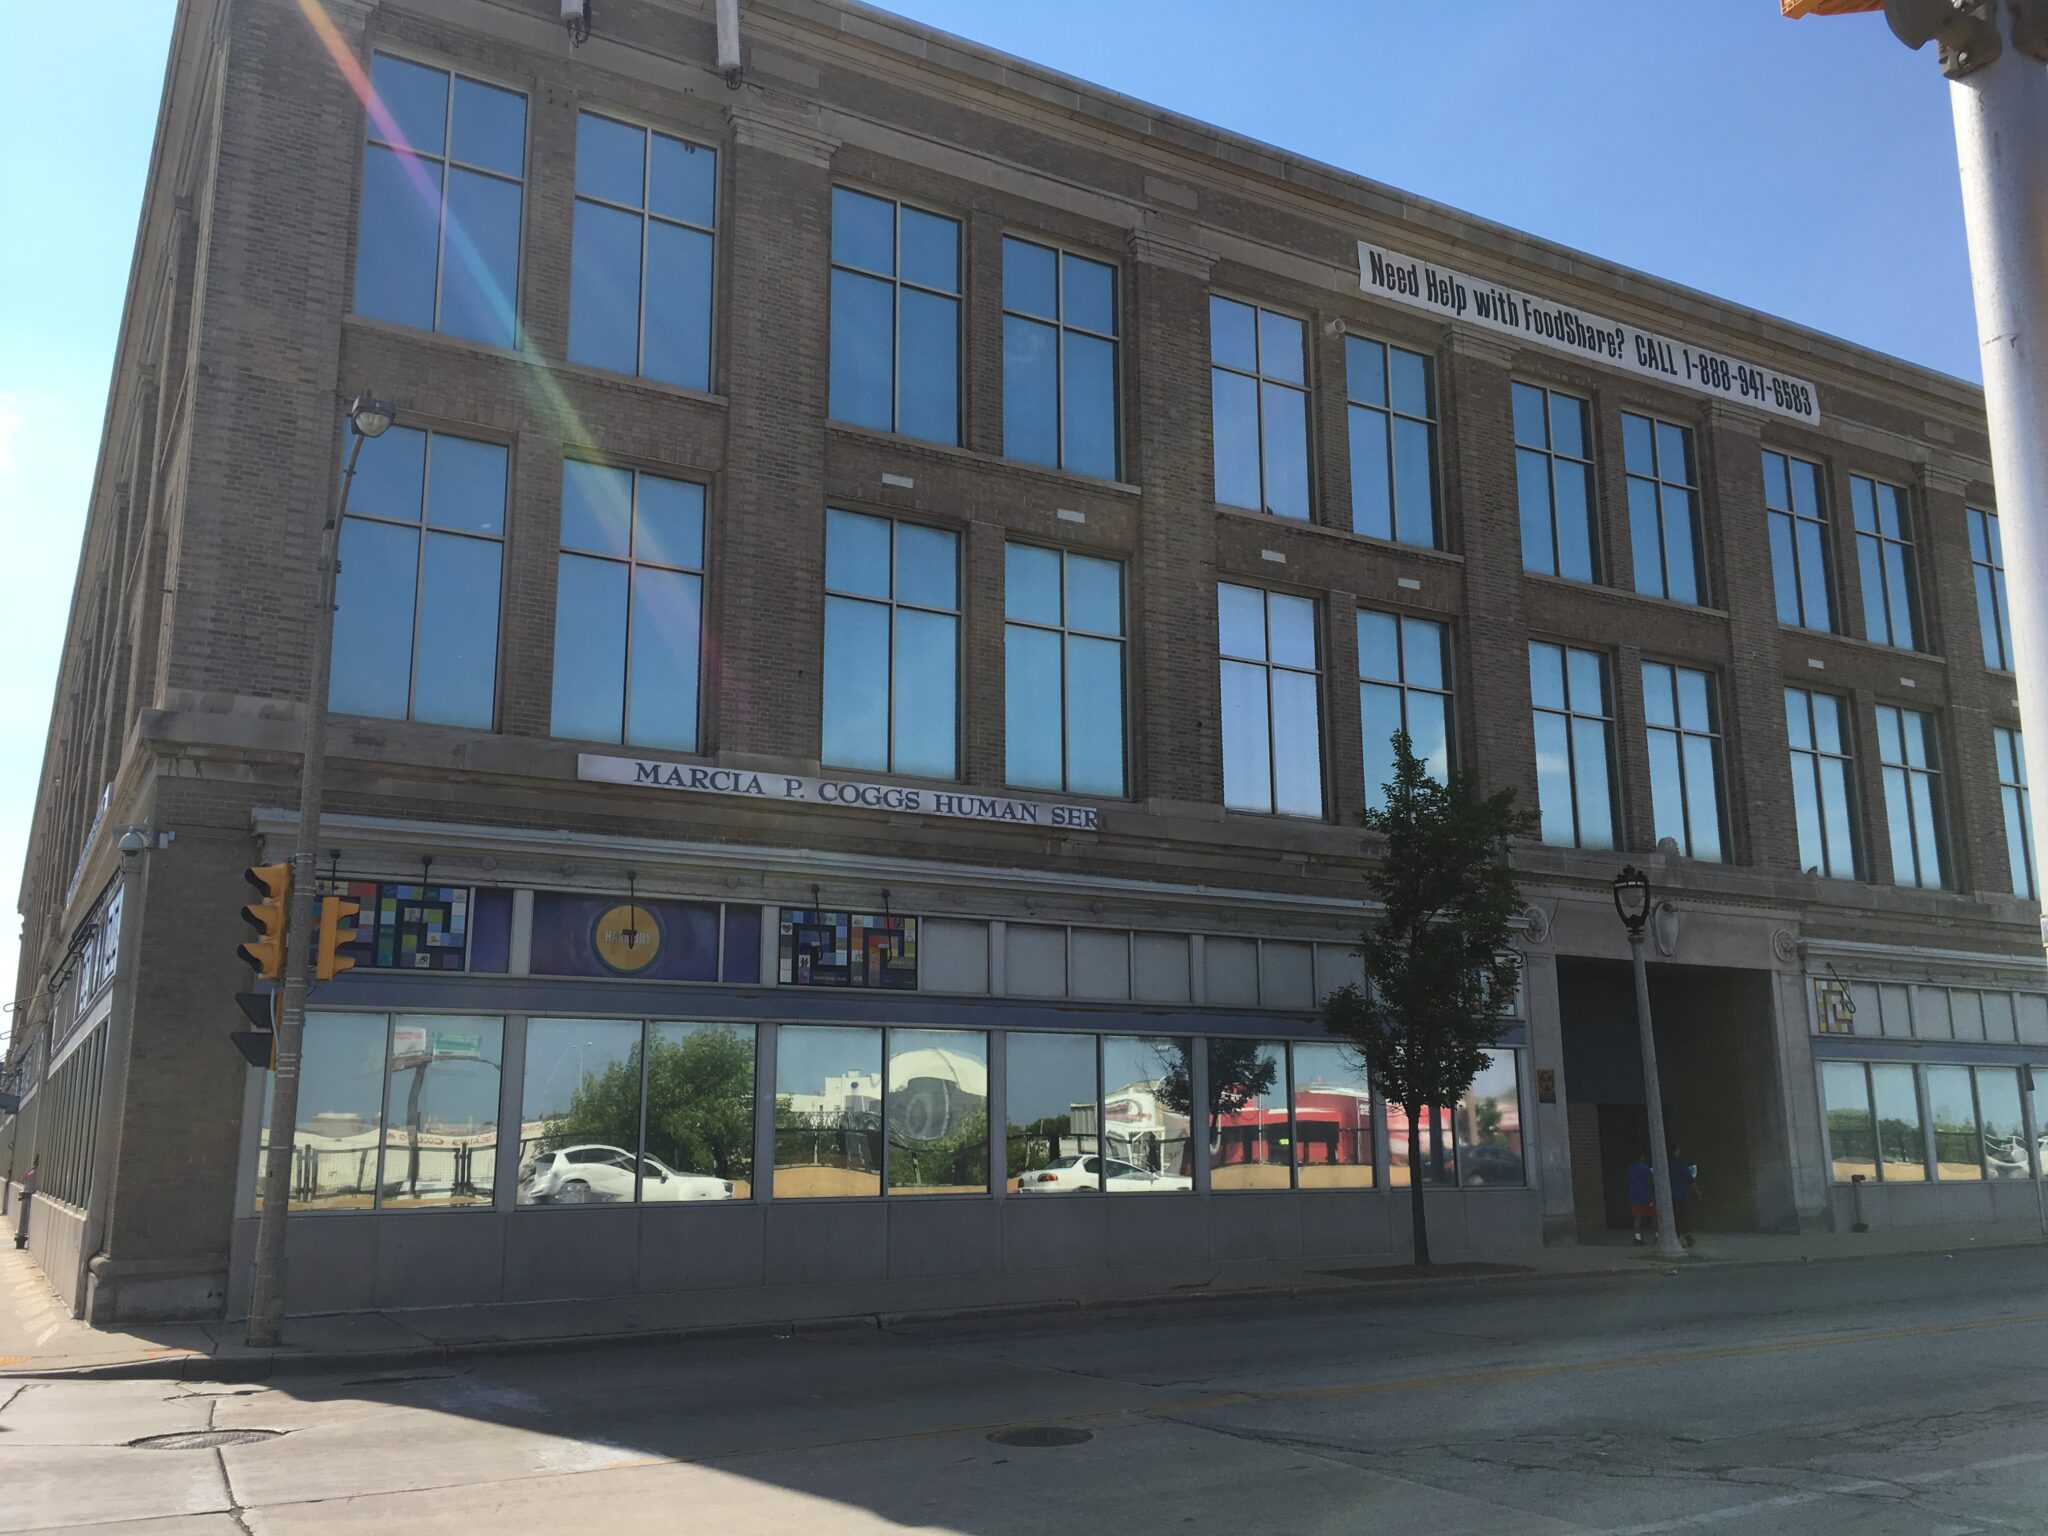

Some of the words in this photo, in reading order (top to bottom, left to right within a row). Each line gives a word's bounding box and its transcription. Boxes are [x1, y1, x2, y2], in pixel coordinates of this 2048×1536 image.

[1369, 250, 1420, 298] Need
[1424, 267, 1468, 316] Help
[1473, 288, 1520, 328] with
[1522, 298, 1625, 359] FoodShare?
[1634, 334, 1678, 376] CALL
[1683, 349, 1812, 416] 1-888-947-6583
[634, 762, 766, 796] MARCIA
[783, 778, 805, 799] P.
[818, 782, 920, 811] COGGS
[933, 793, 1040, 822] HUMAN
[1051, 806, 1098, 828] SER
